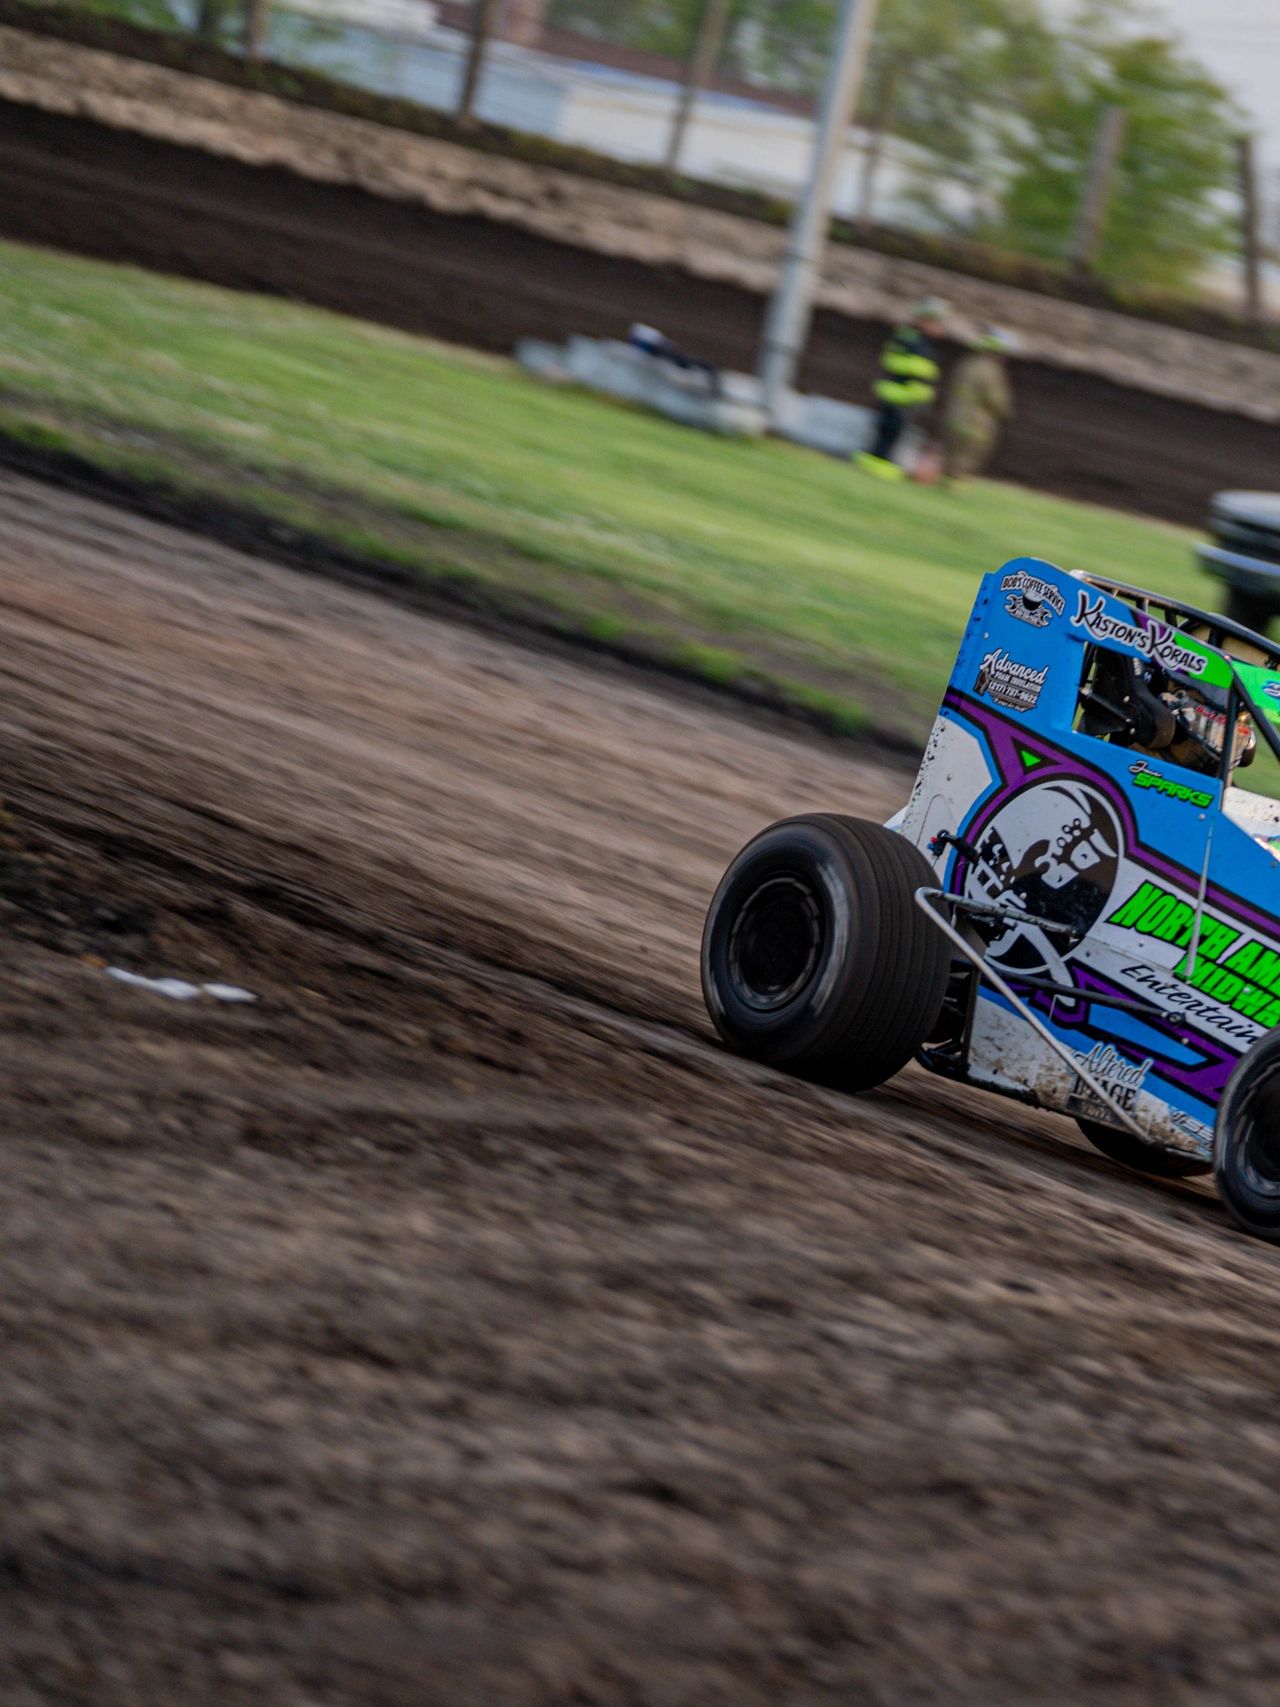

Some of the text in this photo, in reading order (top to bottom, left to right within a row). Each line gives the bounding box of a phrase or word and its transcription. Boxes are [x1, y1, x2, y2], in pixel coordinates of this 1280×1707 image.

[980, 648, 1049, 684] Advanced
[1146, 623, 1207, 672] KORALS
[1133, 772, 1213, 808] SPARKS
[1104, 880, 1243, 962] NORTH
[1074, 1042, 1153, 1087] Altered
